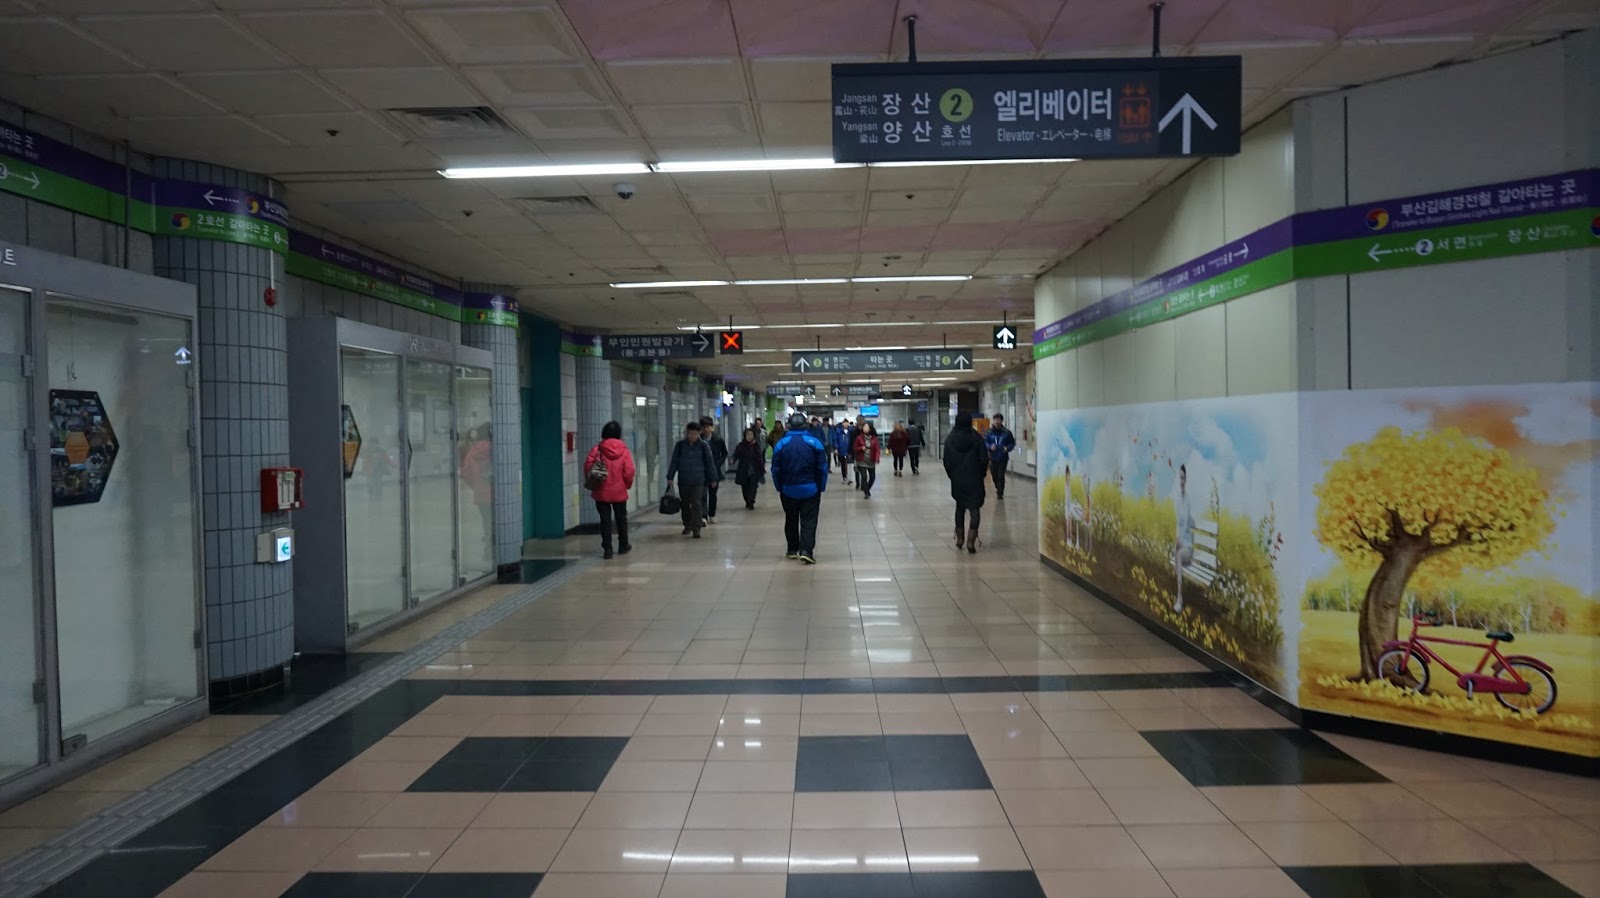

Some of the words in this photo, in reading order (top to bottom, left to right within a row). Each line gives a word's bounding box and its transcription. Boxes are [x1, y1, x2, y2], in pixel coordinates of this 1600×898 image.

[841, 92, 878, 105] Jangsan
[949, 94, 963, 116] 2
[994, 88, 1113, 122] 엘리베이터
[841, 121, 878, 134] Yangsan
[997, 128, 1035, 142] Elevator
[1400, 190, 1492, 217] 부산김해경전철
[1497, 182, 1555, 205] 갈아타는
[1560, 179, 1577, 196] 곳
[609, 337, 684, 347] 무인민원발급기
